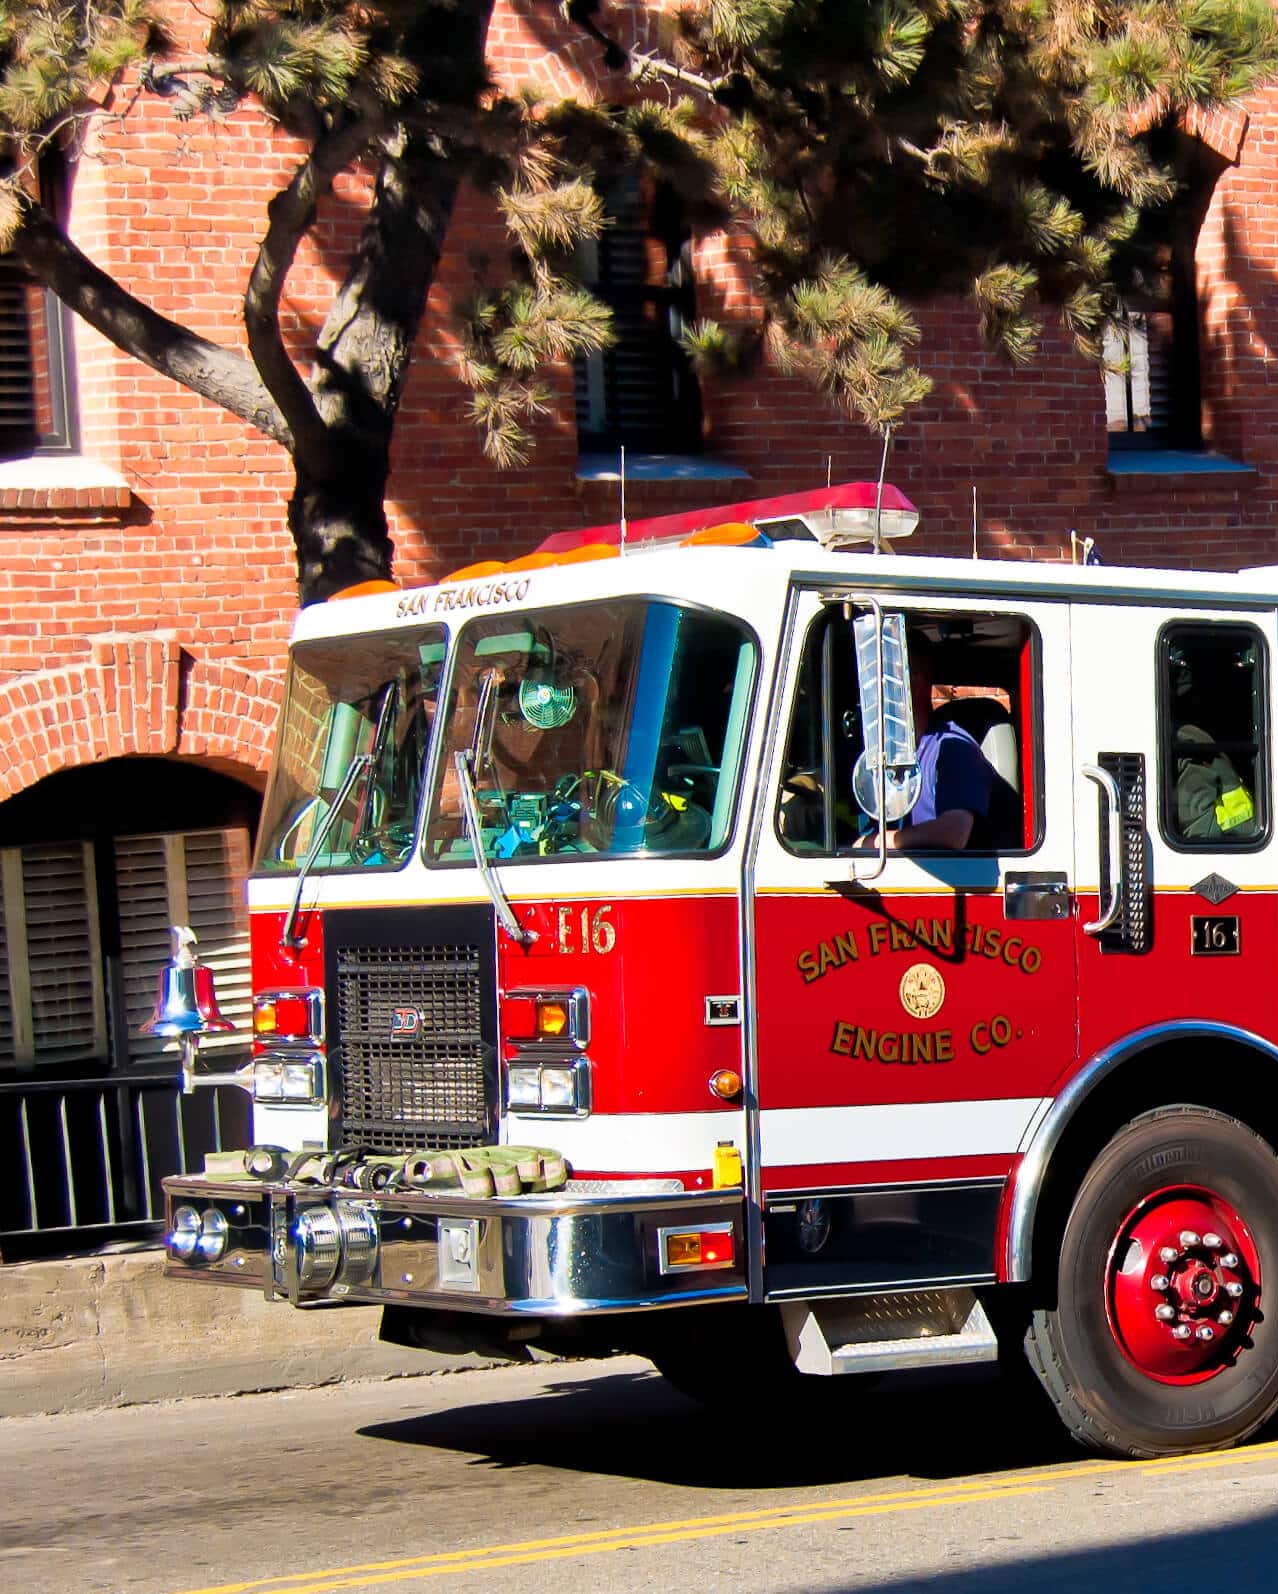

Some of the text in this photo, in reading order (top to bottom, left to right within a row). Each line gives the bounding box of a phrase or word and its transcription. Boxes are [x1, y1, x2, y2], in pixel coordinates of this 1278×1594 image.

[396, 578, 531, 618] SAN FRANCISCO
[558, 904, 616, 955] E16
[796, 917, 1042, 984] SAN FRANCISCO
[1204, 920, 1226, 948] 16
[830, 1014, 1023, 1064] ENGINE CO.
